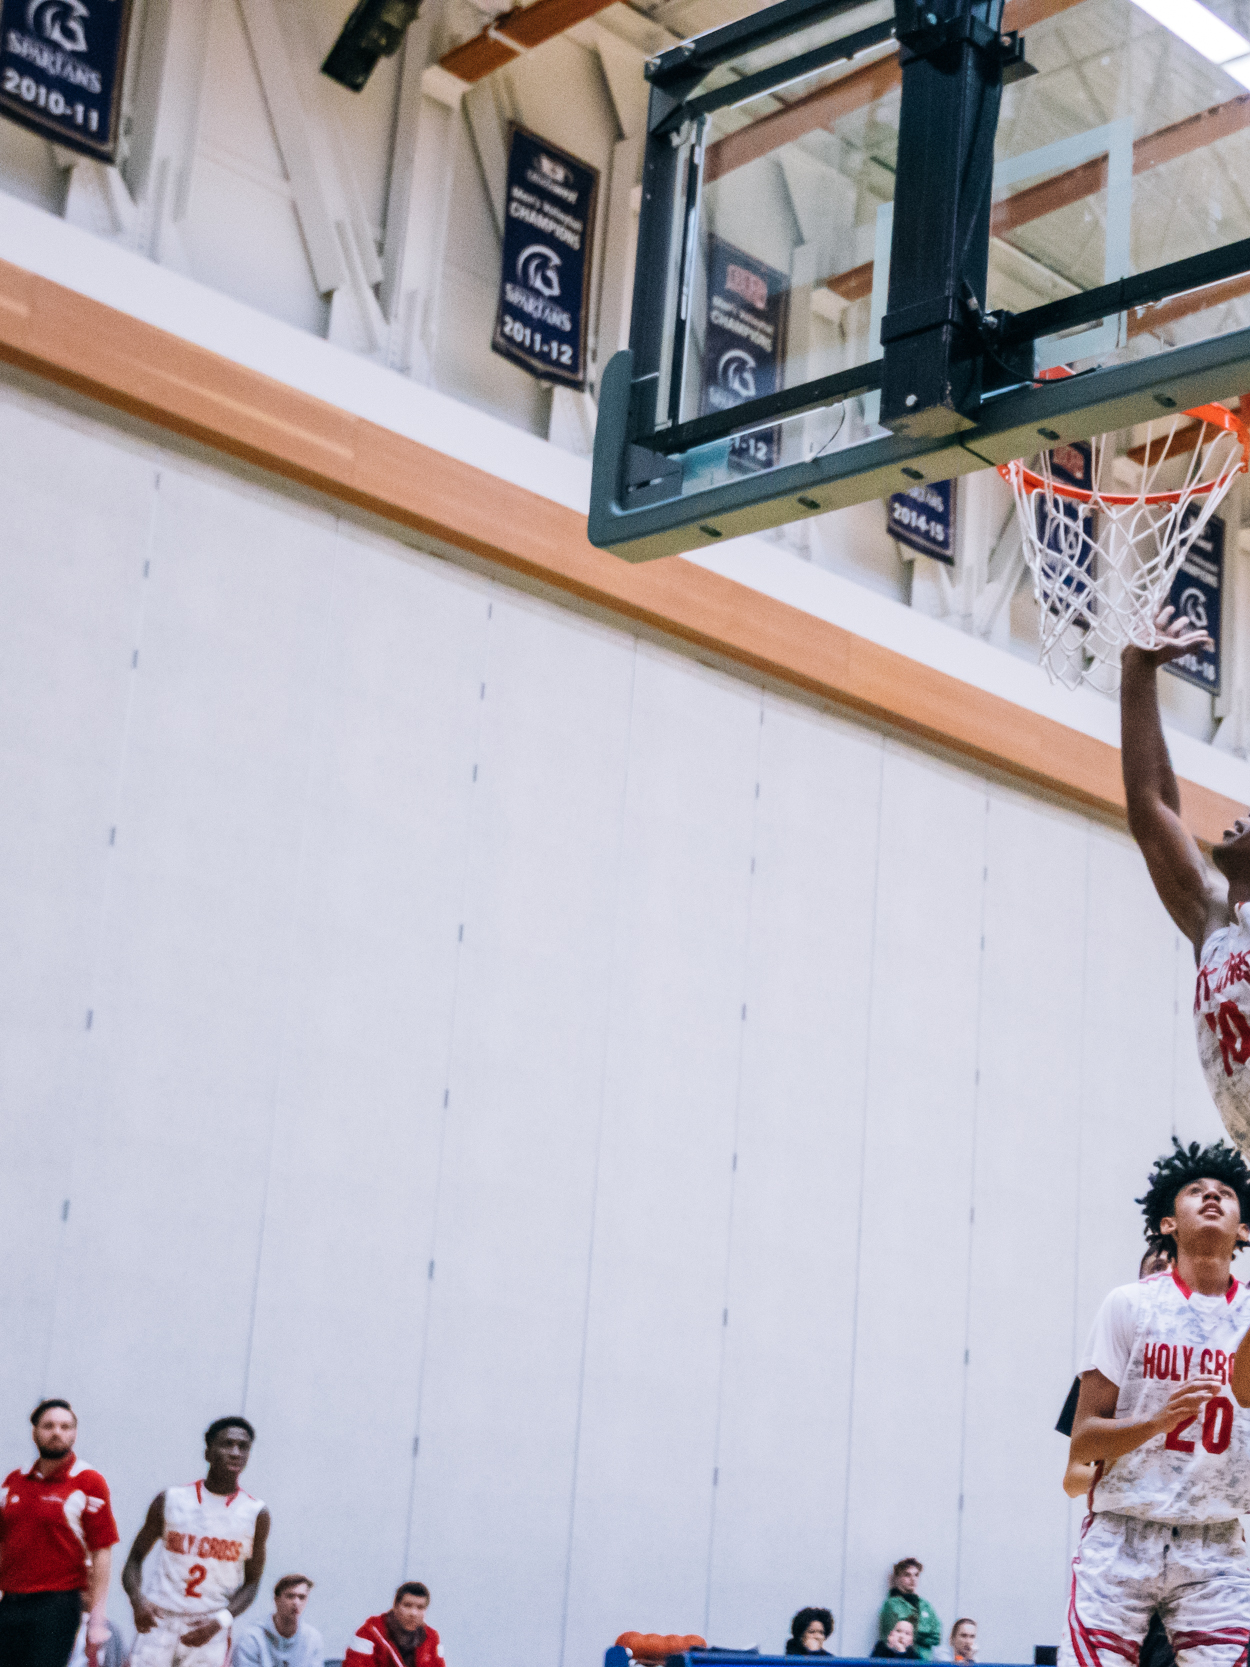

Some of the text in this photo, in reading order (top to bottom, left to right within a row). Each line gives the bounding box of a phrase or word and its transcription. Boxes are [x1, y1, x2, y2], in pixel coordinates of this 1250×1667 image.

[3, 66, 100, 132] 2010-11
[502, 314, 574, 366] 2011-12
[1143, 1342, 1194, 1382] HOLY
[1165, 1396, 1234, 1455] 20
[197, 1536, 243, 1562] CROSS
[185, 1565, 207, 1598] 2
